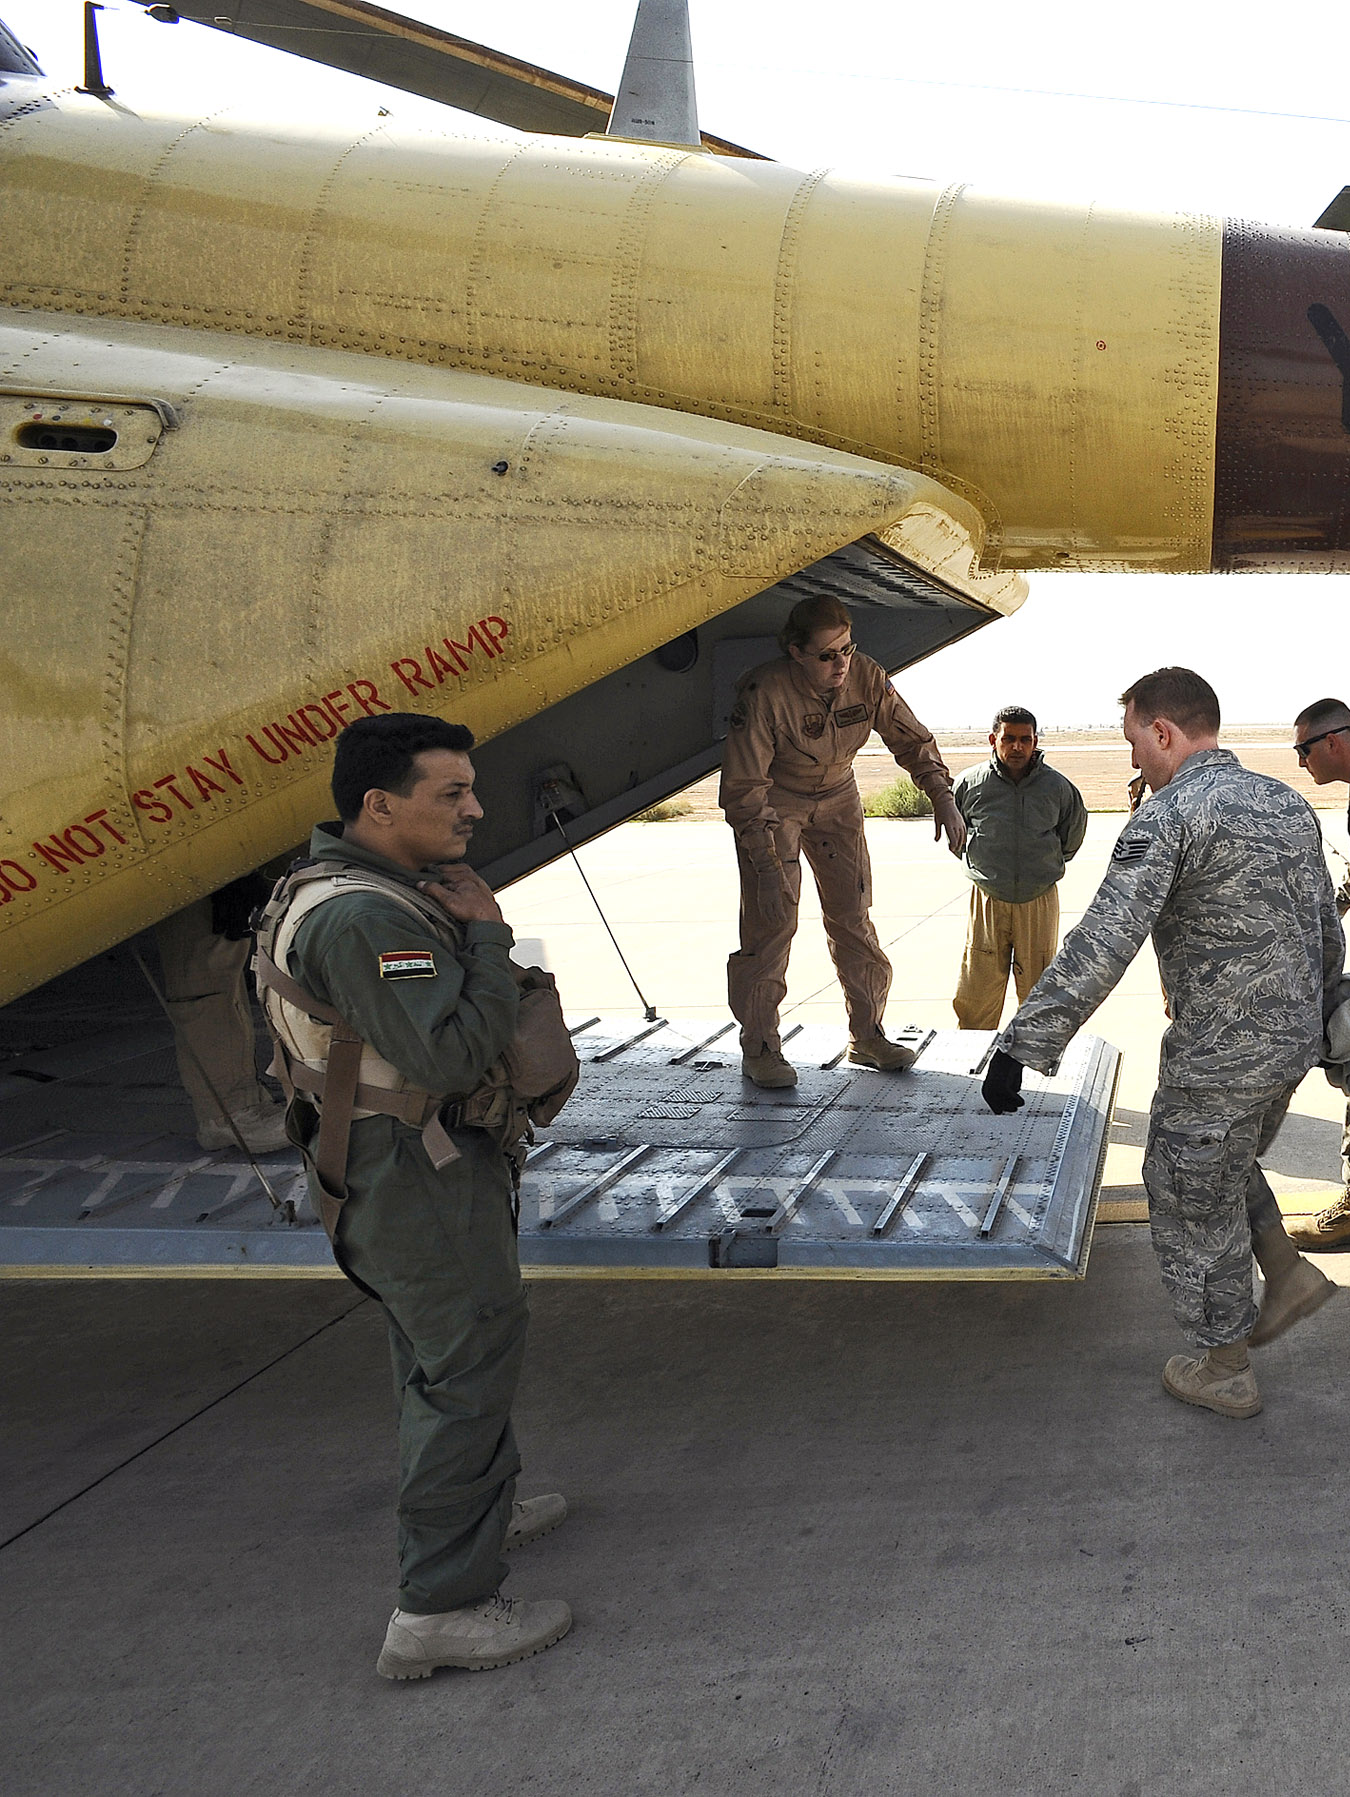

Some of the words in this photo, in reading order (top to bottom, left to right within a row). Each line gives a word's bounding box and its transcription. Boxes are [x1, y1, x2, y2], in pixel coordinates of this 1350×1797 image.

[32, 809, 127, 874] NOT
[132, 748, 244, 824] STAY
[245, 679, 393, 765] UNDER
[389, 615, 510, 697] RAMP
